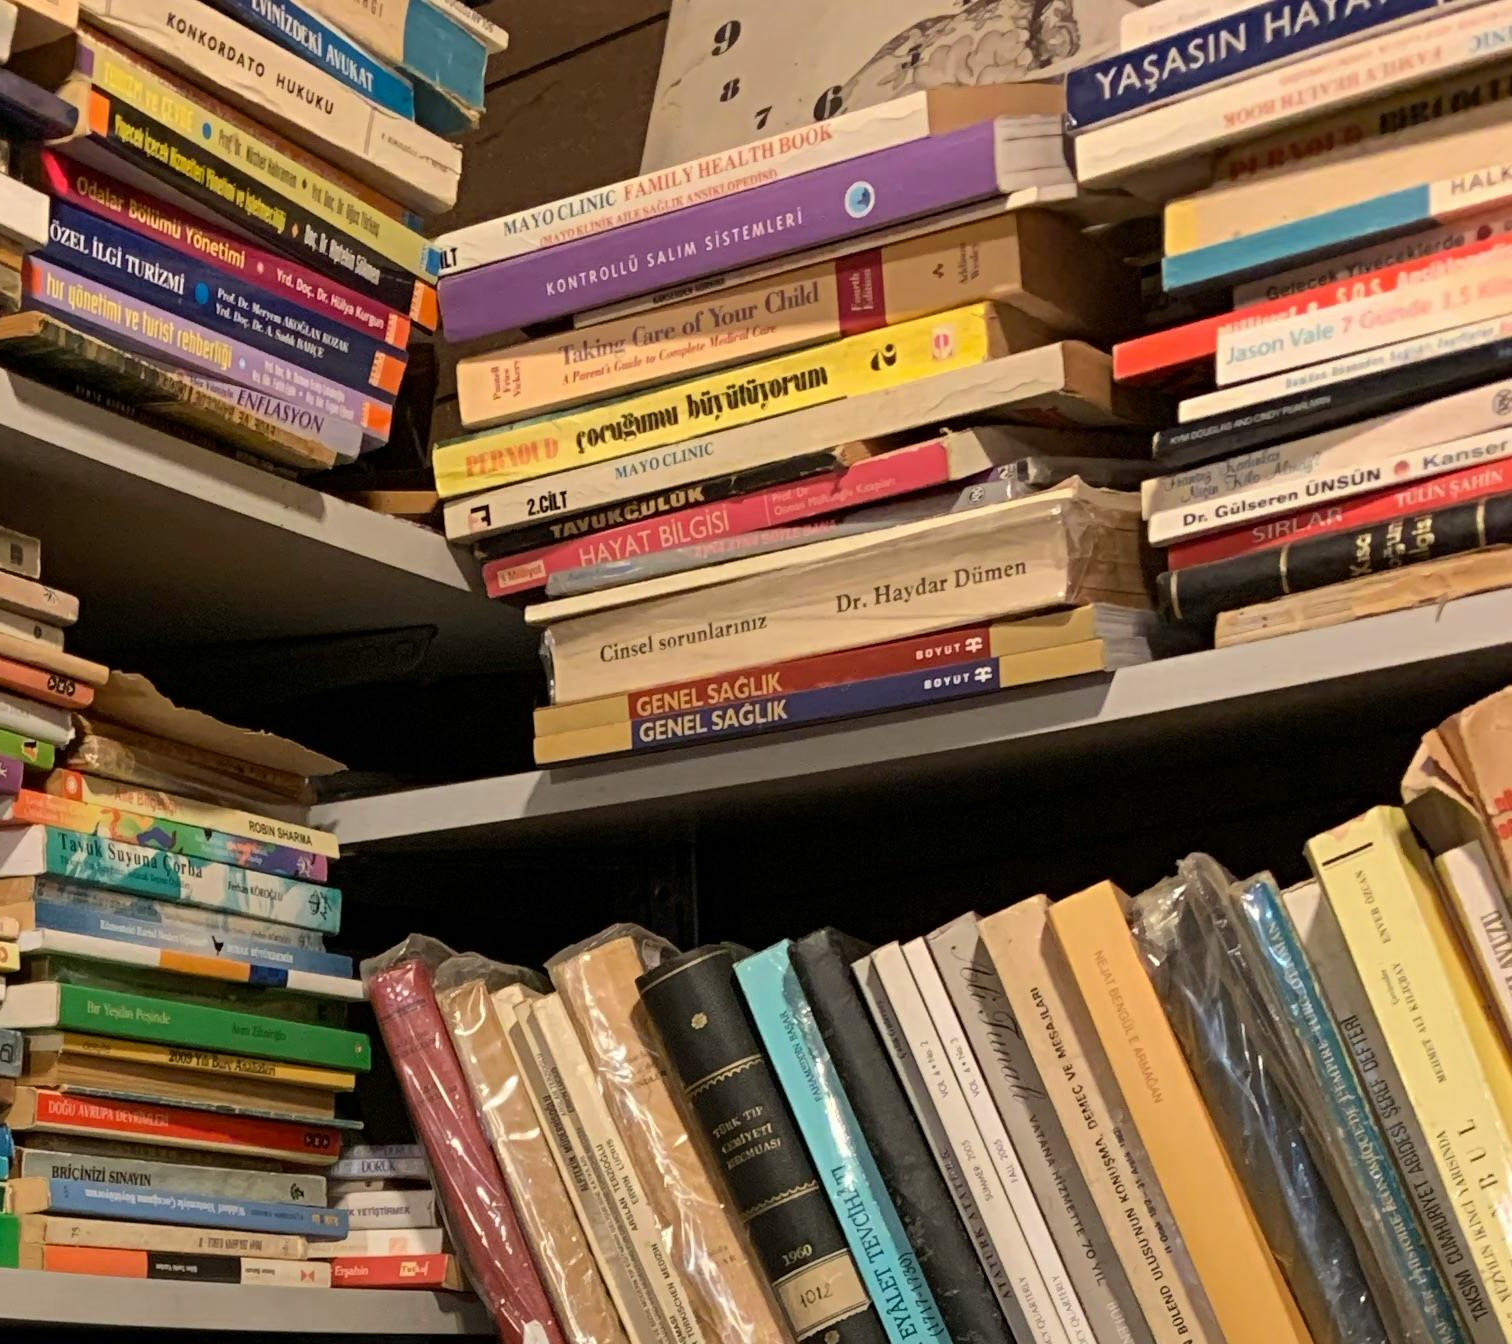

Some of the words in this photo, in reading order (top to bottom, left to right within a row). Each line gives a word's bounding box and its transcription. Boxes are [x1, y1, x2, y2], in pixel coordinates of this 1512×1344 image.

[165, 12, 268, 81] KONKORDATO
[274, 72, 335, 117] HUKUKU
[1097, 25, 1248, 102] YAŞASIN
[502, 201, 557, 237] MAYO
[557, 189, 617, 223] CLINIC
[623, 163, 695, 204] FAMILY
[696, 141, 776, 183] HEALTH
[778, 124, 834, 160] BOOK
[75, 175, 125, 213] Odalar
[126, 191, 183, 239] Bölümü
[184, 217, 247, 270] Yönetimi
[545, 255, 640, 297] KONTROLLÜ
[646, 241, 699, 270] SALIM
[704, 207, 805, 253] SİSTEMLERİ
[558, 324, 626, 366] Taking
[631, 321, 677, 352] Care
[680, 307, 704, 335] of
[707, 294, 759, 329] Your
[764, 281, 821, 317] Child
[1225, 331, 1287, 367] Jason
[1291, 321, 1336, 355] Vale
[575, 405, 679, 456] çocuğumu
[686, 365, 831, 421] büyütüyorum
[614, 452, 660, 480] MAYO
[660, 441, 715, 472] CLINIC
[1182, 510, 1210, 528] Dr.
[1213, 485, 1300, 522] Gülseren
[1305, 463, 1382, 500] ÜNSÜN
[578, 528, 651, 568] HAYAT
[656, 509, 730, 552] BİLGİSİ
[835, 588, 868, 614] Dr.
[872, 571, 948, 607] Haydar
[953, 557, 1027, 588] Dümen
[598, 633, 653, 665] Cinsel
[658, 613, 768, 652] sorunlarınız
[915, 641, 961, 660] BOYUT
[635, 683, 701, 718] GENEL
[705, 669, 782, 708] SAĞLIK
[638, 712, 704, 744] GENEL
[707, 696, 788, 734] SAĞLIK
[248, 820, 274, 838] ROBIN
[276, 827, 313, 847] SHARMA
[781, 1244, 814, 1265] 1960
